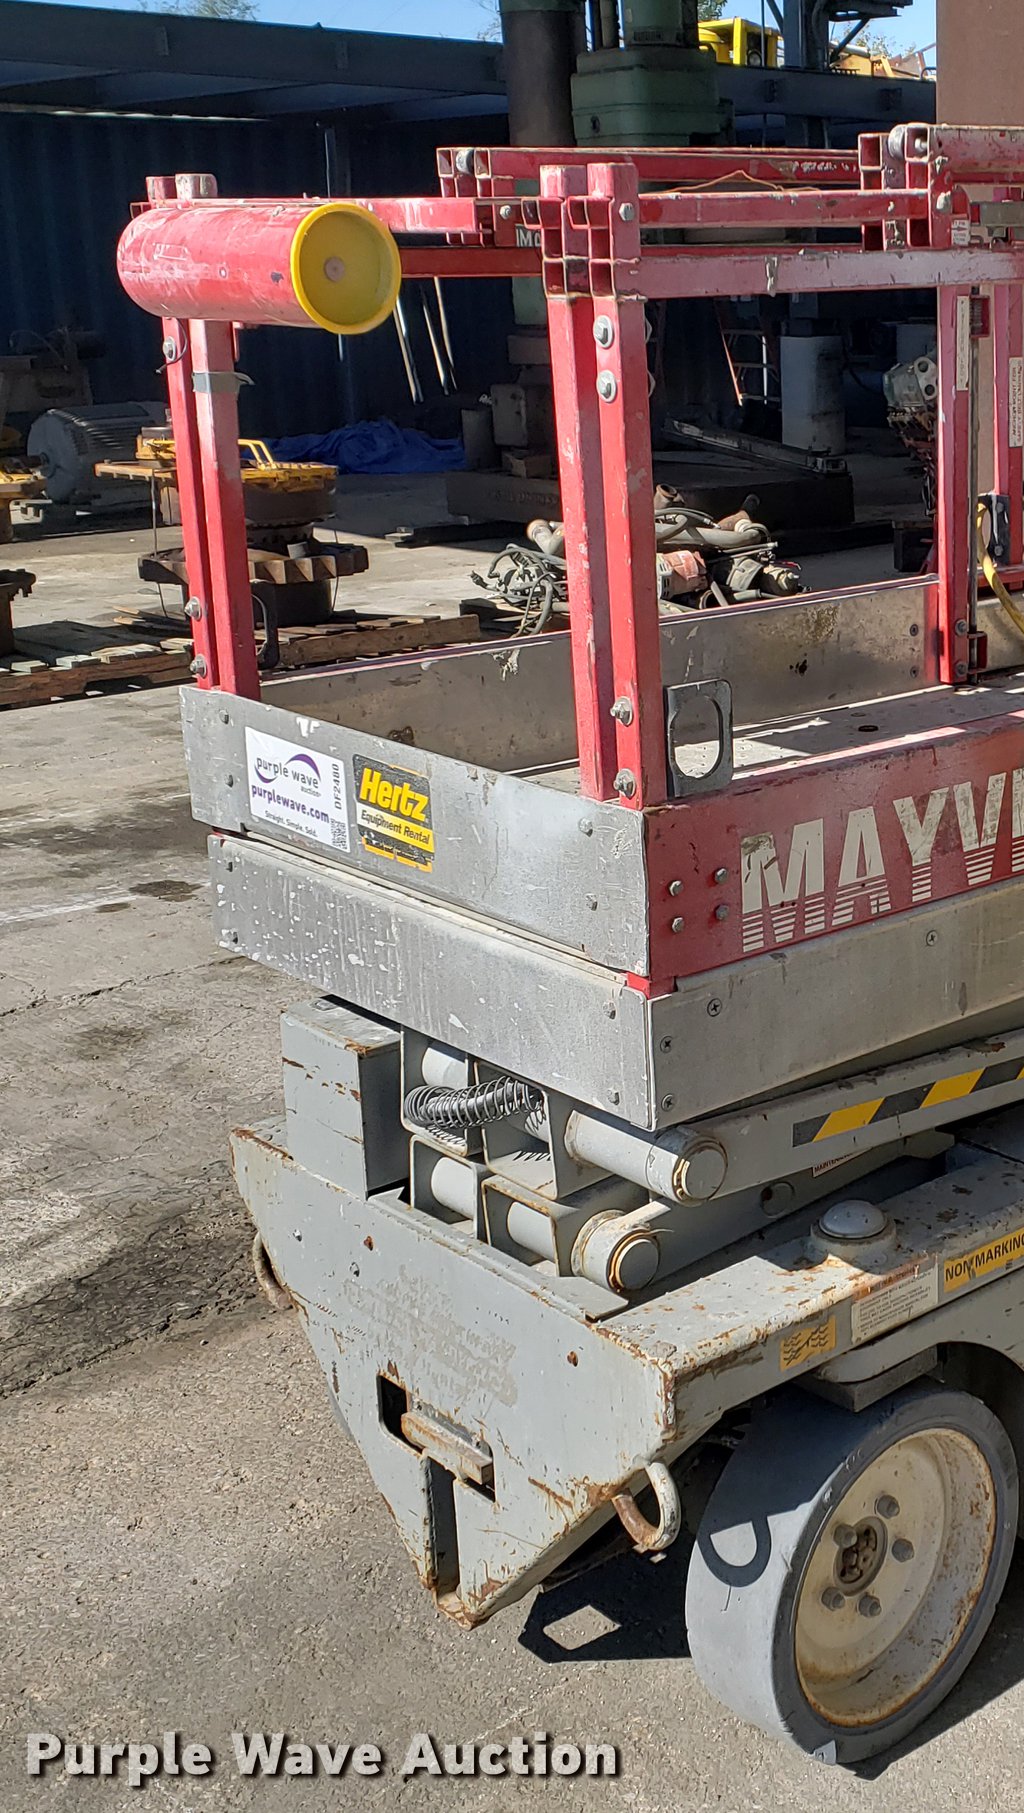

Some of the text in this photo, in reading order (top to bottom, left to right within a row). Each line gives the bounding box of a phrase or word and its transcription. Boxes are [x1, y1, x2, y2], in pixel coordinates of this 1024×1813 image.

[256, 757, 319, 789] purple wave
[251, 784, 330, 824] purplewave.com
[360, 767, 429, 822] Hertz
[361, 809, 431, 845] Equipment Rental
